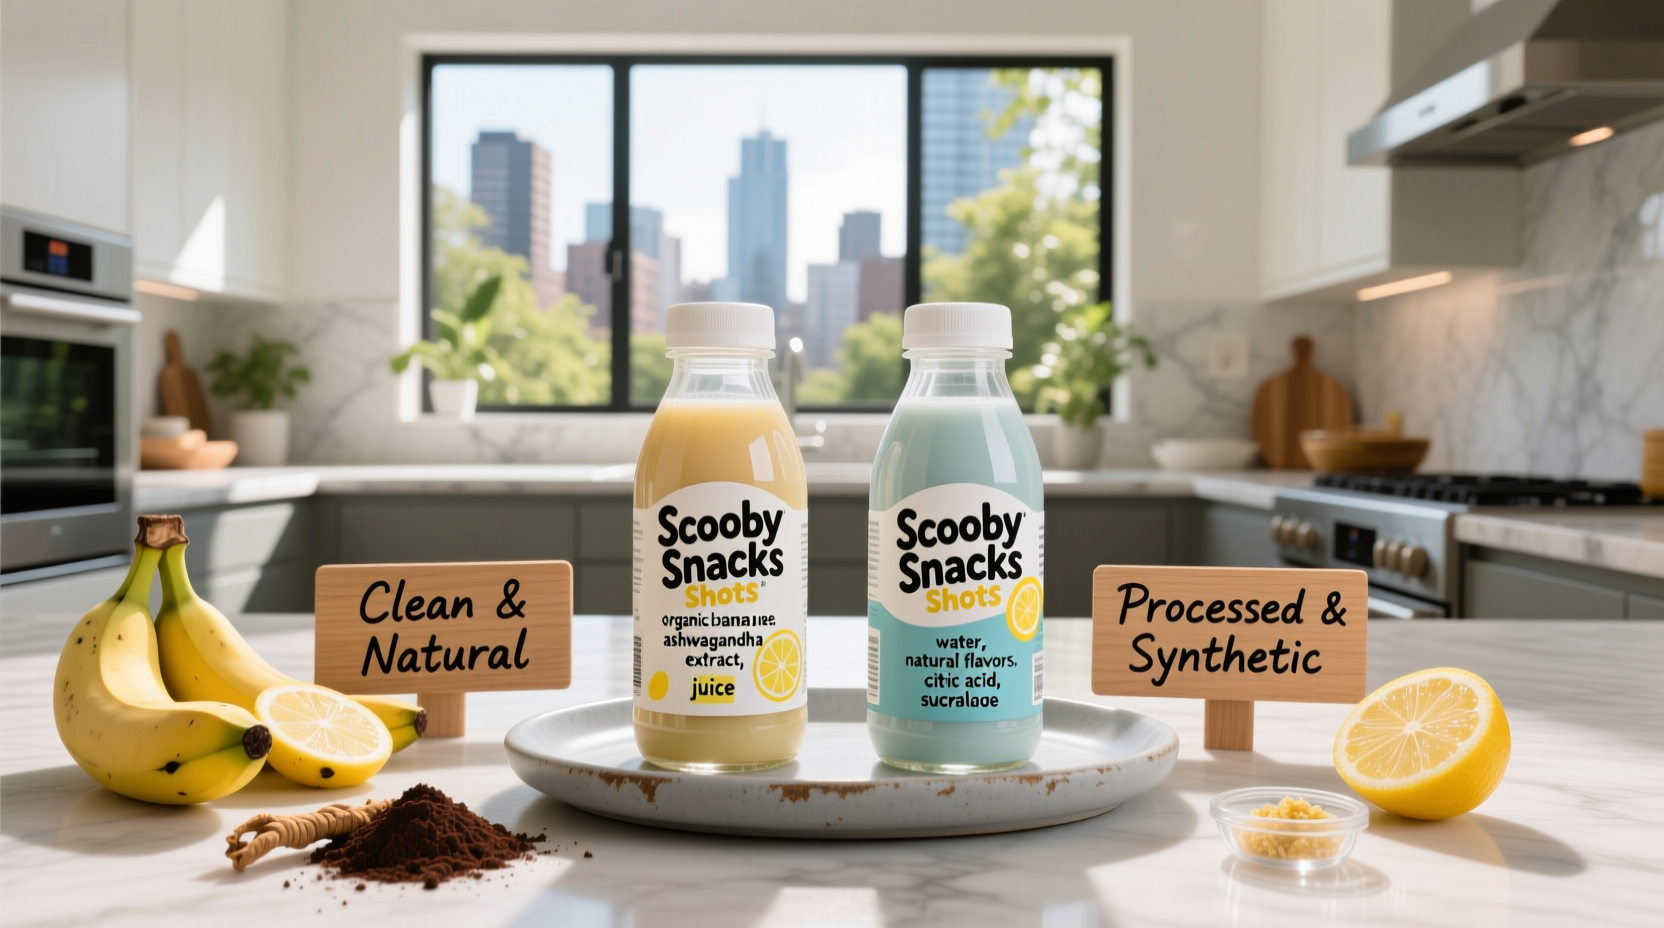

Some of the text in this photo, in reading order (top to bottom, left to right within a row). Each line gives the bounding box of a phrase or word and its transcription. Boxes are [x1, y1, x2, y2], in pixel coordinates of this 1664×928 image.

[658, 500, 783, 547] Scooby
[897, 502, 1022, 550] Scooby
[662, 541, 784, 589] Snacks
[899, 544, 1022, 594] Snacks
[359, 578, 526, 624] Clean &
[685, 582, 759, 609] Shots
[926, 585, 1002, 613] Shots
[1117, 582, 1347, 627] Processed &
[662, 612, 709, 631] organic
[361, 627, 530, 677] Natural
[663, 631, 763, 651] ashwagandha
[936, 635, 987, 651] water,
[685, 652, 744, 670] extract,
[905, 652, 959, 669] natural
[1128, 632, 1323, 687] Synthetic
[690, 677, 735, 701] juice
[965, 671, 1001, 690] acid,
